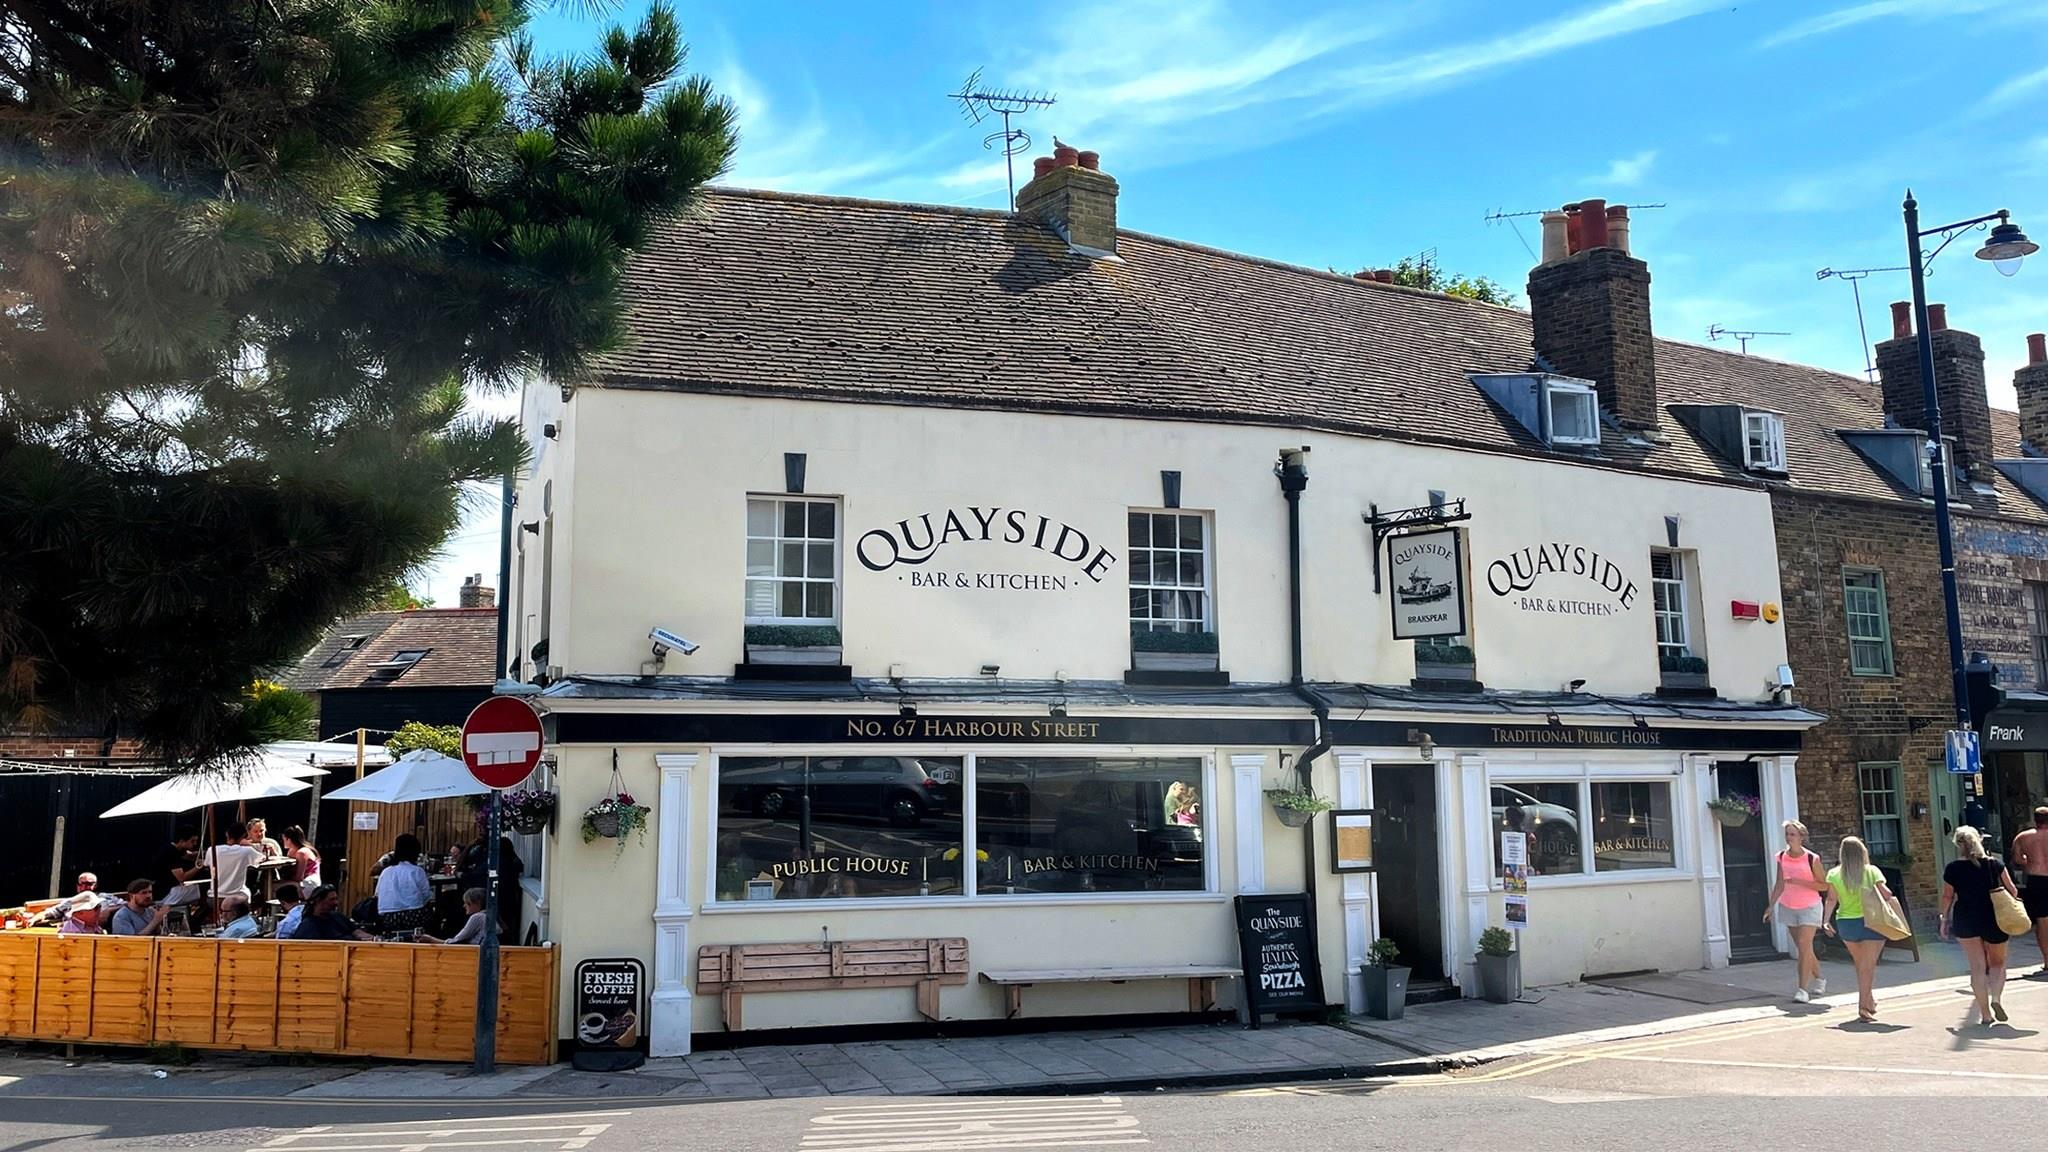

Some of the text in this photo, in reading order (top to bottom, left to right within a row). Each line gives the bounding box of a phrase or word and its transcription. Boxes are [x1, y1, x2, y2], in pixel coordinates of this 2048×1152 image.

[856, 506, 1117, 583] QUAYSIDE
[1395, 543, 1453, 565] QUAYSIDE
[1487, 543, 1638, 610] QUAYSIDE
[1989, 564, 2008, 577] FOR
[911, 571, 1067, 591] BAR & KITCHEN
[1521, 597, 1611, 616] BAR & KITCHEN
[1408, 613, 1448, 624] BRAKSPEAR
[893, 720, 917, 737] 67
[924, 720, 1024, 737] HARBOUR
[1031, 720, 1100, 738] STREET
[1492, 728, 1661, 745] TRADITIONAL PUBLIC HOUSE
[1990, 725, 2024, 741] Frank
[1594, 837, 1669, 853] BAR & KITCHEN
[772, 857, 910, 878] PUBLIC HOUSE
[1023, 854, 1158, 874] BAR & KITCHEN
[1266, 908, 1280, 917] The
[1251, 916, 1303, 932] QUAYSIDE
[1262, 943, 1295, 952] AUTHENTIC
[584, 972, 635, 984] FRESH
[1260, 971, 1305, 989] PIZZA
[584, 985, 634, 994] COFFEE
[246, 1111, 632, 1152] LEF
